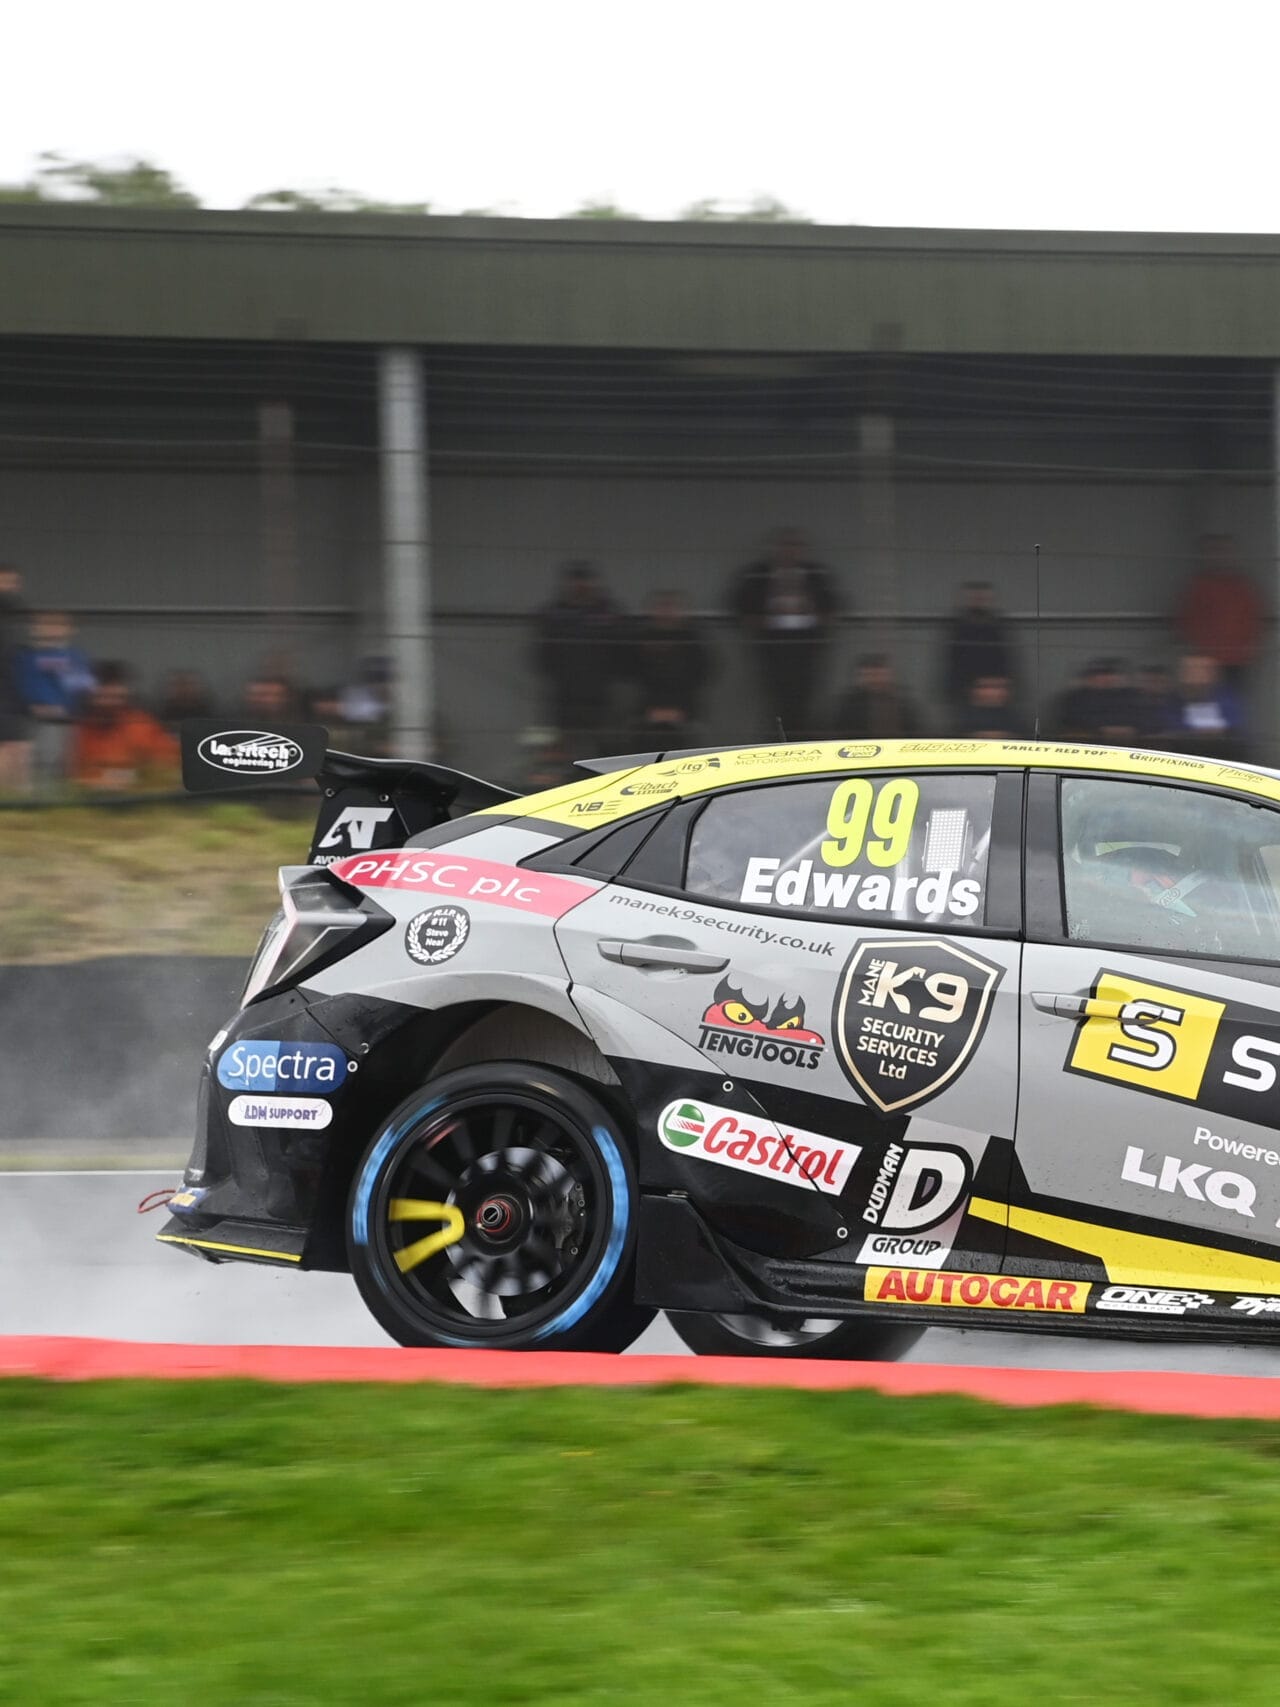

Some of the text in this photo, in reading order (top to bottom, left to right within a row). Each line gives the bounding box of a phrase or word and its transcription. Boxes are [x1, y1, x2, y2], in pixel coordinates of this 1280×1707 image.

[210, 740, 289, 760] Laertech
[1002, 744, 1050, 752] VARLEY
[1129, 752, 1205, 769] GRIPFIXINGS
[820, 778, 920, 868] 99
[345, 860, 541, 902] PHSC plc
[740, 857, 982, 917] Edwards
[425, 928, 449, 937] Steve
[425, 938, 444, 946] Neal
[609, 894, 837, 957] manek9security.co.uk
[858, 958, 885, 1006] MANE
[872, 960, 969, 1024] K9
[857, 1035, 938, 1067] SERVICES
[860, 1017, 945, 1048] SECURITY
[228, 1046, 335, 1086] Spectra
[878, 1060, 907, 1080] Ltd
[269, 1108, 318, 1121] SUPPORT
[703, 1116, 845, 1186] Castrol
[862, 1142, 904, 1225] DUDMAN
[881, 1149, 966, 1229] D
[1121, 1145, 1257, 1218] LKQ
[872, 1237, 941, 1256] GROUP
[876, 1269, 1080, 1311] AUTOCAR
[1101, 1289, 1184, 1306] ONE
